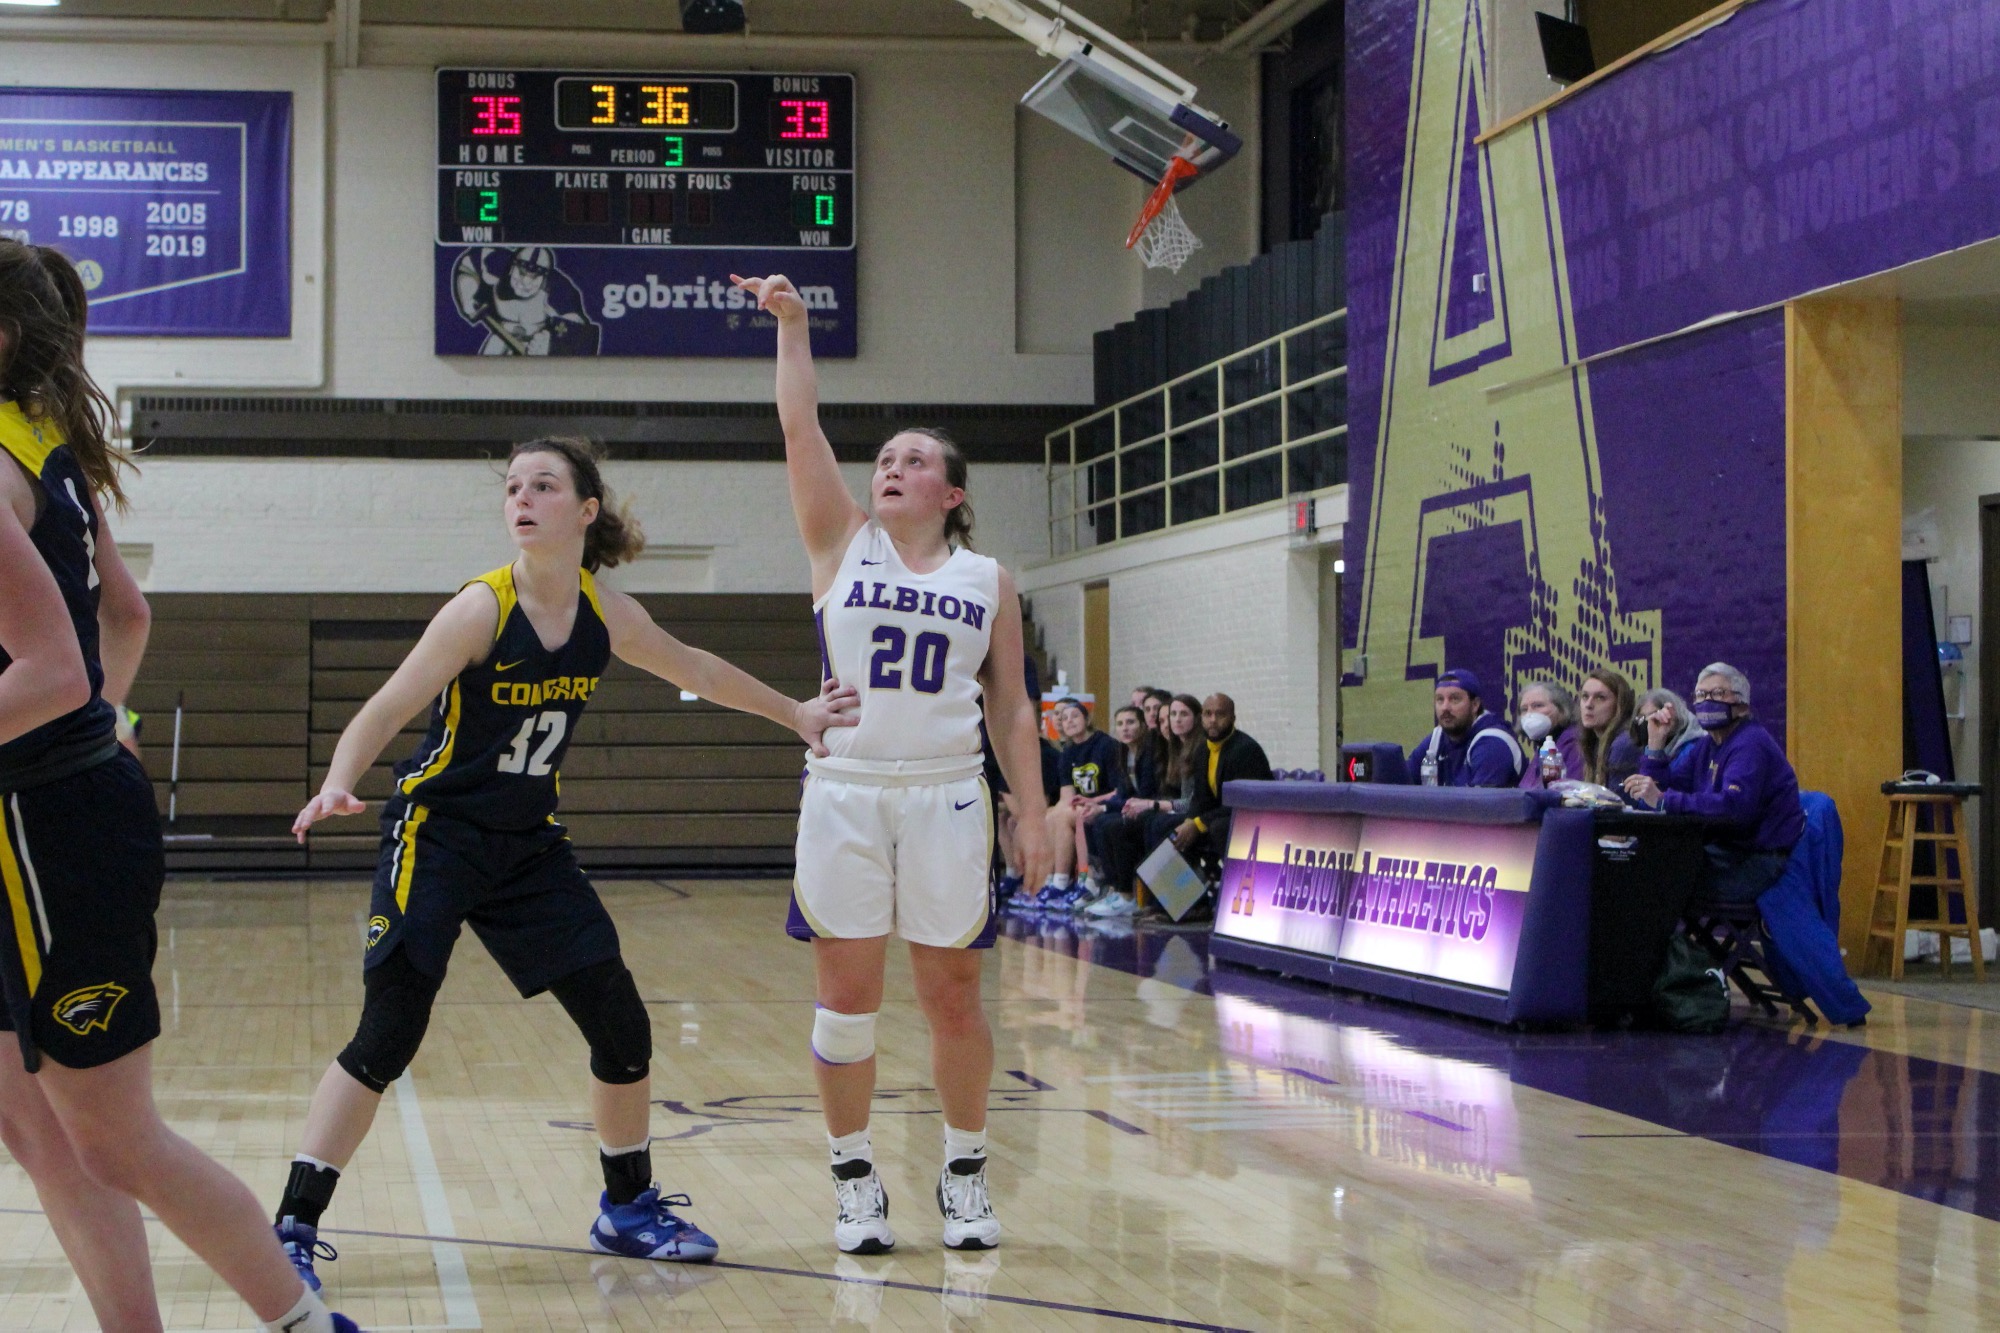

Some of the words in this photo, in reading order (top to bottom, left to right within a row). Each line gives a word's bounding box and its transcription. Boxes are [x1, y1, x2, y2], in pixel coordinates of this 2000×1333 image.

[468, 73, 515, 88] BONUS
[773, 78, 819, 93] BONUS
[472, 96, 522, 135] 35
[1744, 42, 1898, 168] COLLEGE
[780, 100, 829, 139] 33
[62, 140, 177, 154] BASKETBALL
[459, 145, 524, 163] HOME
[610, 149, 655, 163] PERIOD
[665, 136, 683, 166] 3
[766, 149, 835, 167] VISITOR
[35, 160, 208, 182] APPEARANCES
[456, 172, 500, 187] FOULS
[555, 173, 608, 188] PLAYER
[625, 173, 676, 189] POINTS
[687, 174, 731, 190] FOULS
[793, 176, 836, 191] FOULS
[146, 202, 207, 224] 2005
[479, 191, 499, 222] 2
[815, 195, 834, 226] 0
[58, 216, 119, 238] 1998
[462, 227, 493, 243] WON
[632, 228, 671, 244] GAME
[146, 235, 207, 257] 2019
[800, 231, 830, 246] WON
[602, 274, 838, 319] gobrits.m
[844, 581, 986, 631] ALBION
[869, 625, 950, 694] 20
[497, 711, 567, 776] 32
[1231, 825, 1261, 916] A
[1271, 842, 1354, 917] ALBION
[1348, 849, 1498, 943] ATHLETICS
